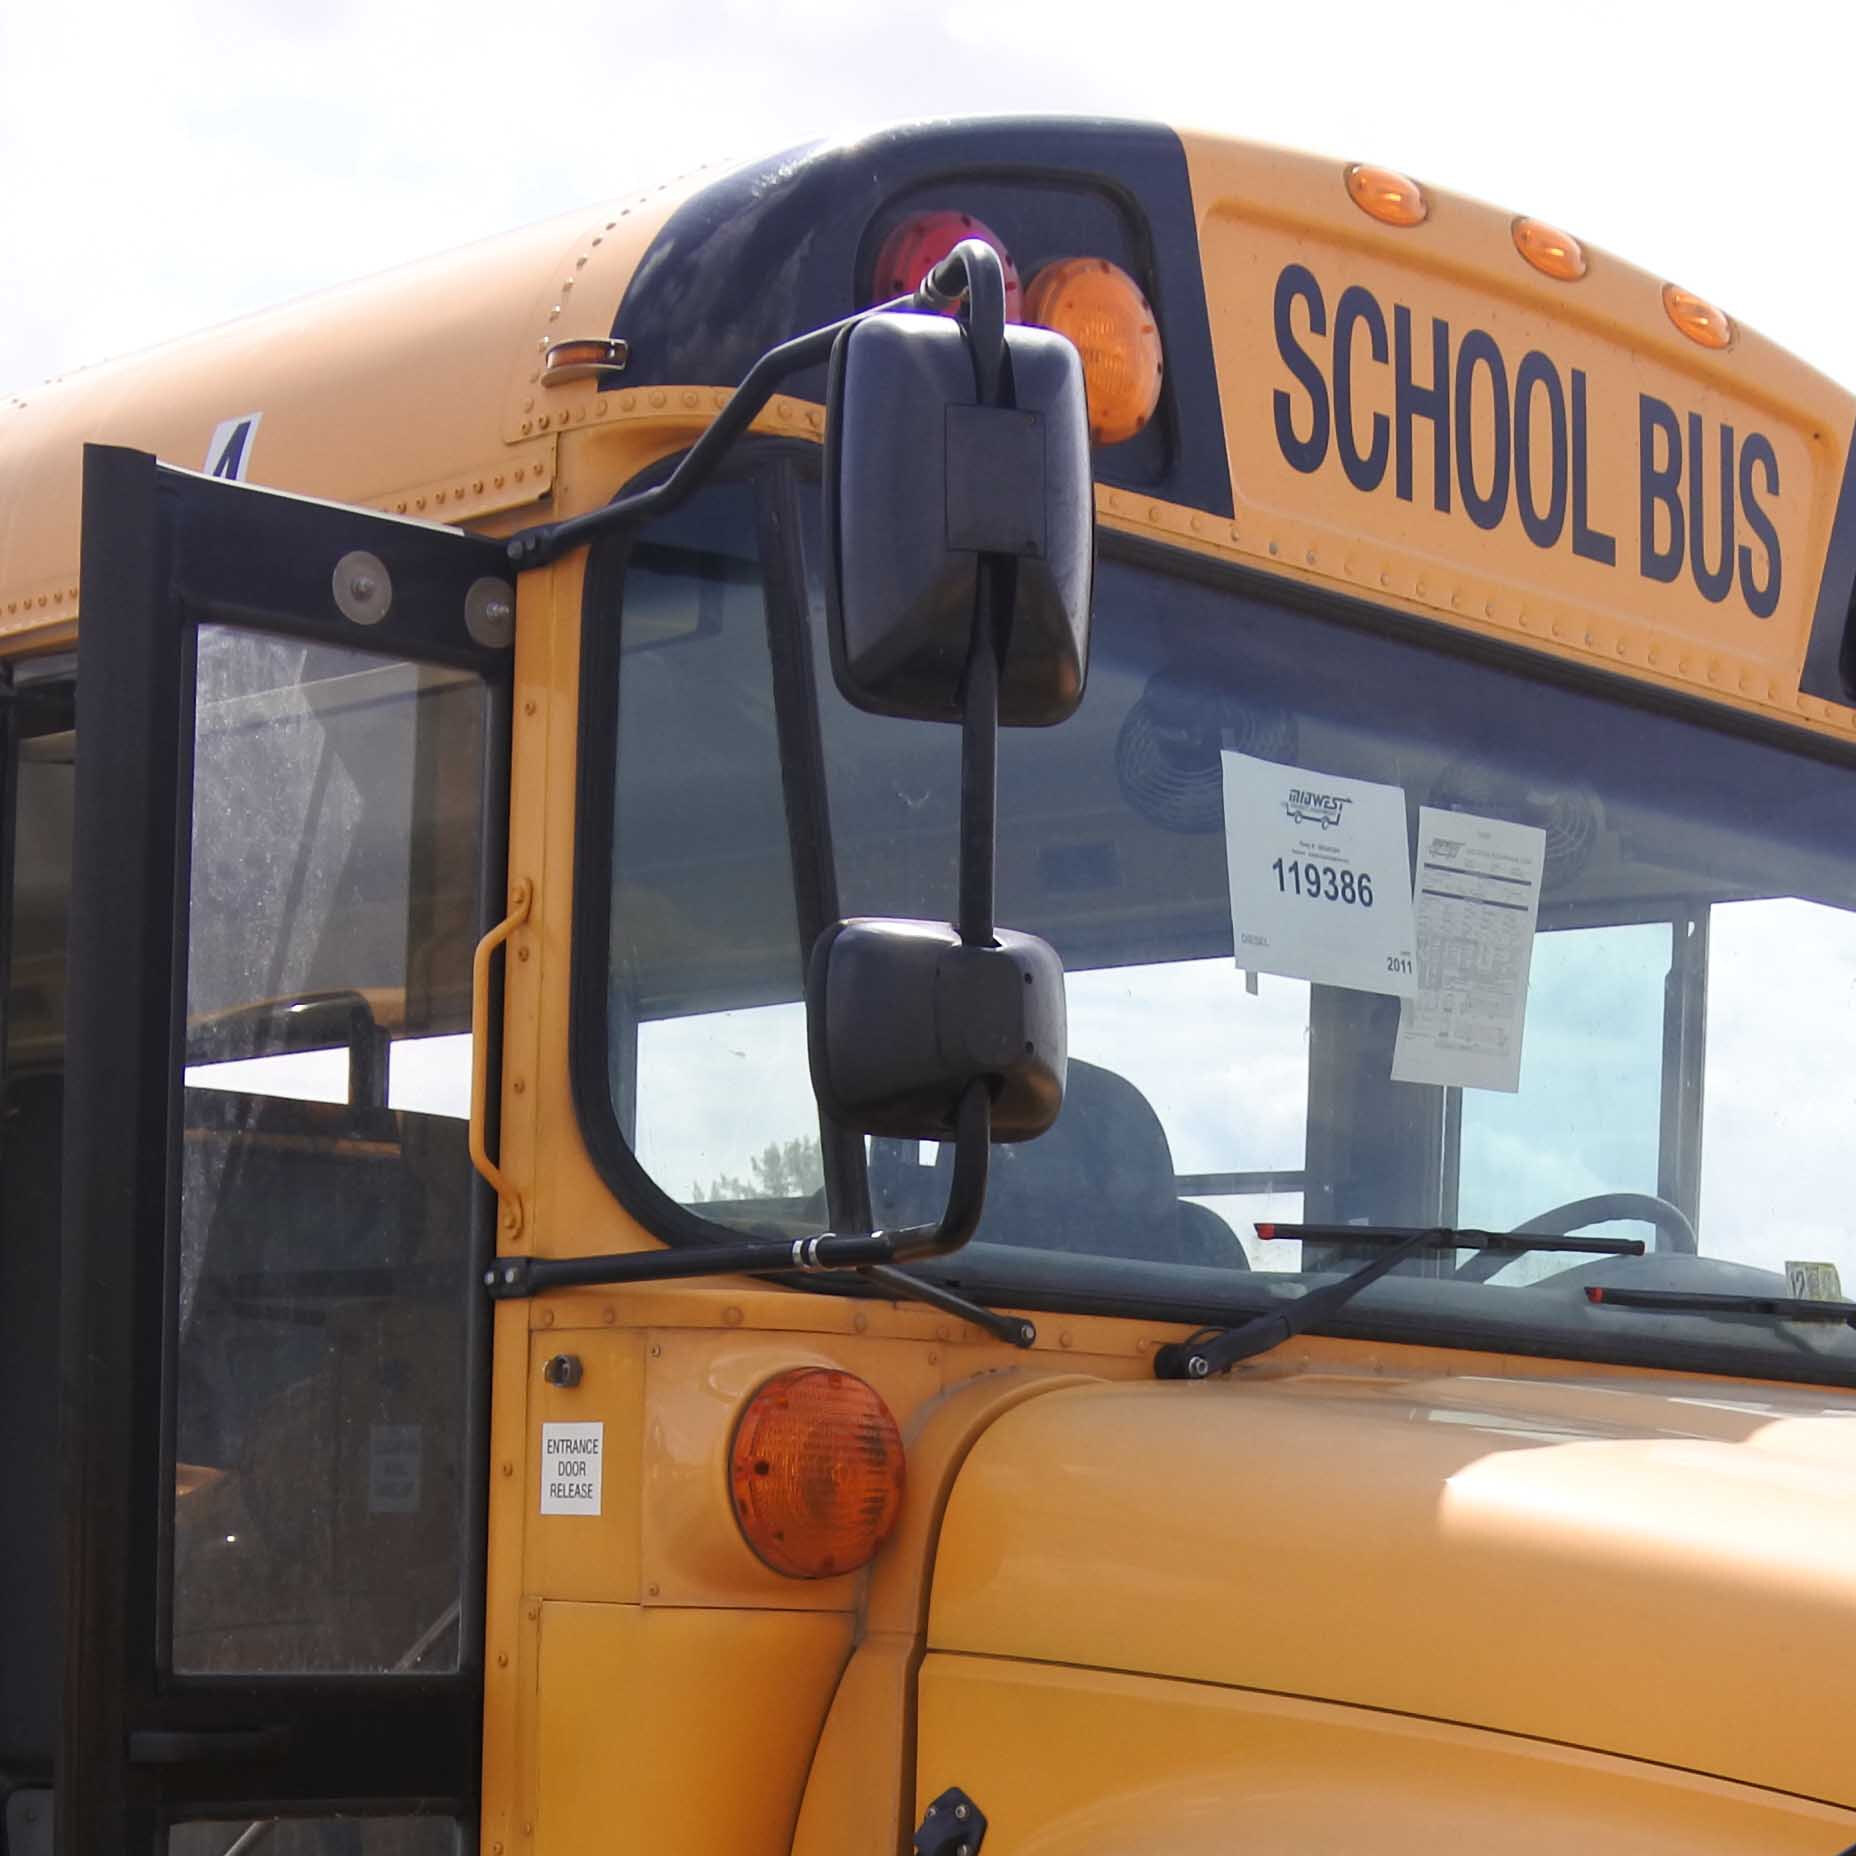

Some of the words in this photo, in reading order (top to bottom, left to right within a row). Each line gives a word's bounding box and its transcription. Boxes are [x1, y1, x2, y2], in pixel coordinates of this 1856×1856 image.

[1273, 264, 1616, 567] SCHOOL
[1639, 393, 1782, 619] BUS
[1272, 857, 1374, 908] 119386
[1386, 956, 1413, 975] 2011
[546, 1437, 600, 1456] ENTRANCE
[557, 1460, 587, 1478] DOOR
[549, 1483, 594, 1500] RELEASE
